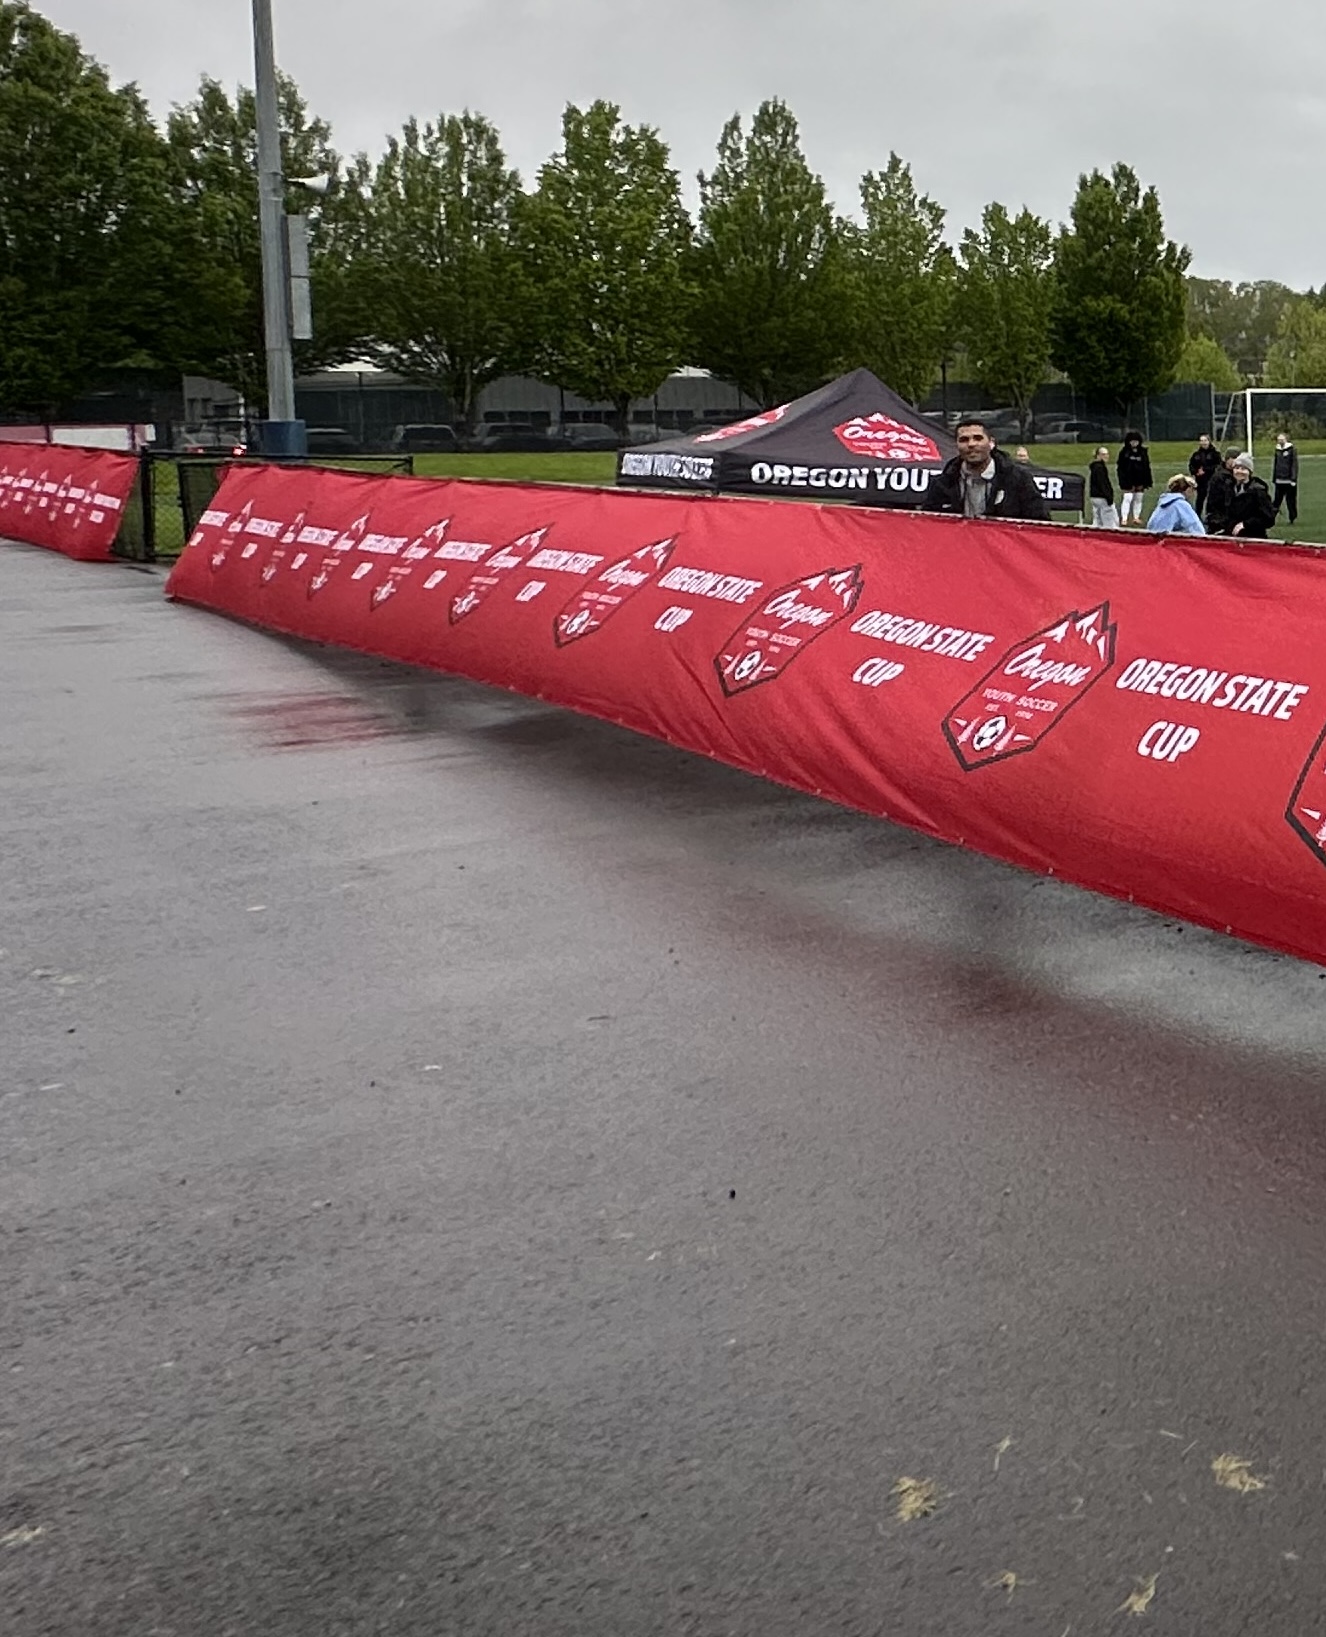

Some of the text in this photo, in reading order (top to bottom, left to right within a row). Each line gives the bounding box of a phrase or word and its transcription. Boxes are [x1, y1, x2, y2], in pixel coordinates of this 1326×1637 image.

[751, 462, 869, 489] OREGON
[850, 610, 995, 661] OREGON STATE
[852, 657, 905, 687] CUP
[1003, 643, 1092, 692] Oregon
[1116, 658, 1309, 720] OREGON STATE
[1137, 720, 1200, 762] CUP
